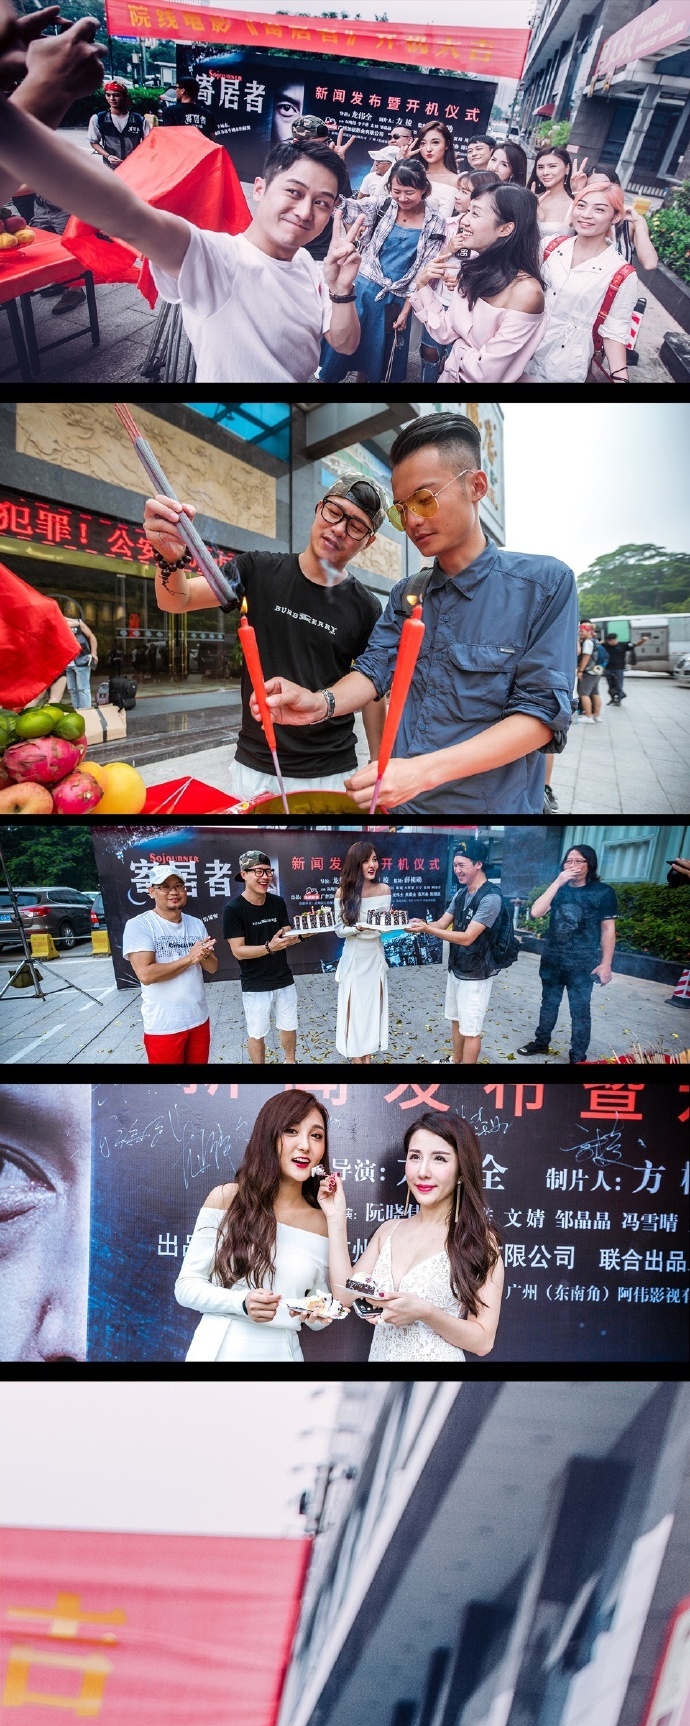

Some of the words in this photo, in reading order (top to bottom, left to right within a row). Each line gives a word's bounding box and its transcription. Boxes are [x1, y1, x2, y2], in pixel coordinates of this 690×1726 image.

[315, 86, 481, 122] 新闻发布暨开机仪式
[555, 1209, 611, 1230] 邹晶晶
[622, 1212, 679, 1233] 冯雪晴
[499, 1243, 576, 1270] 限公司
[3, 1591, 128, 1717] 吉
